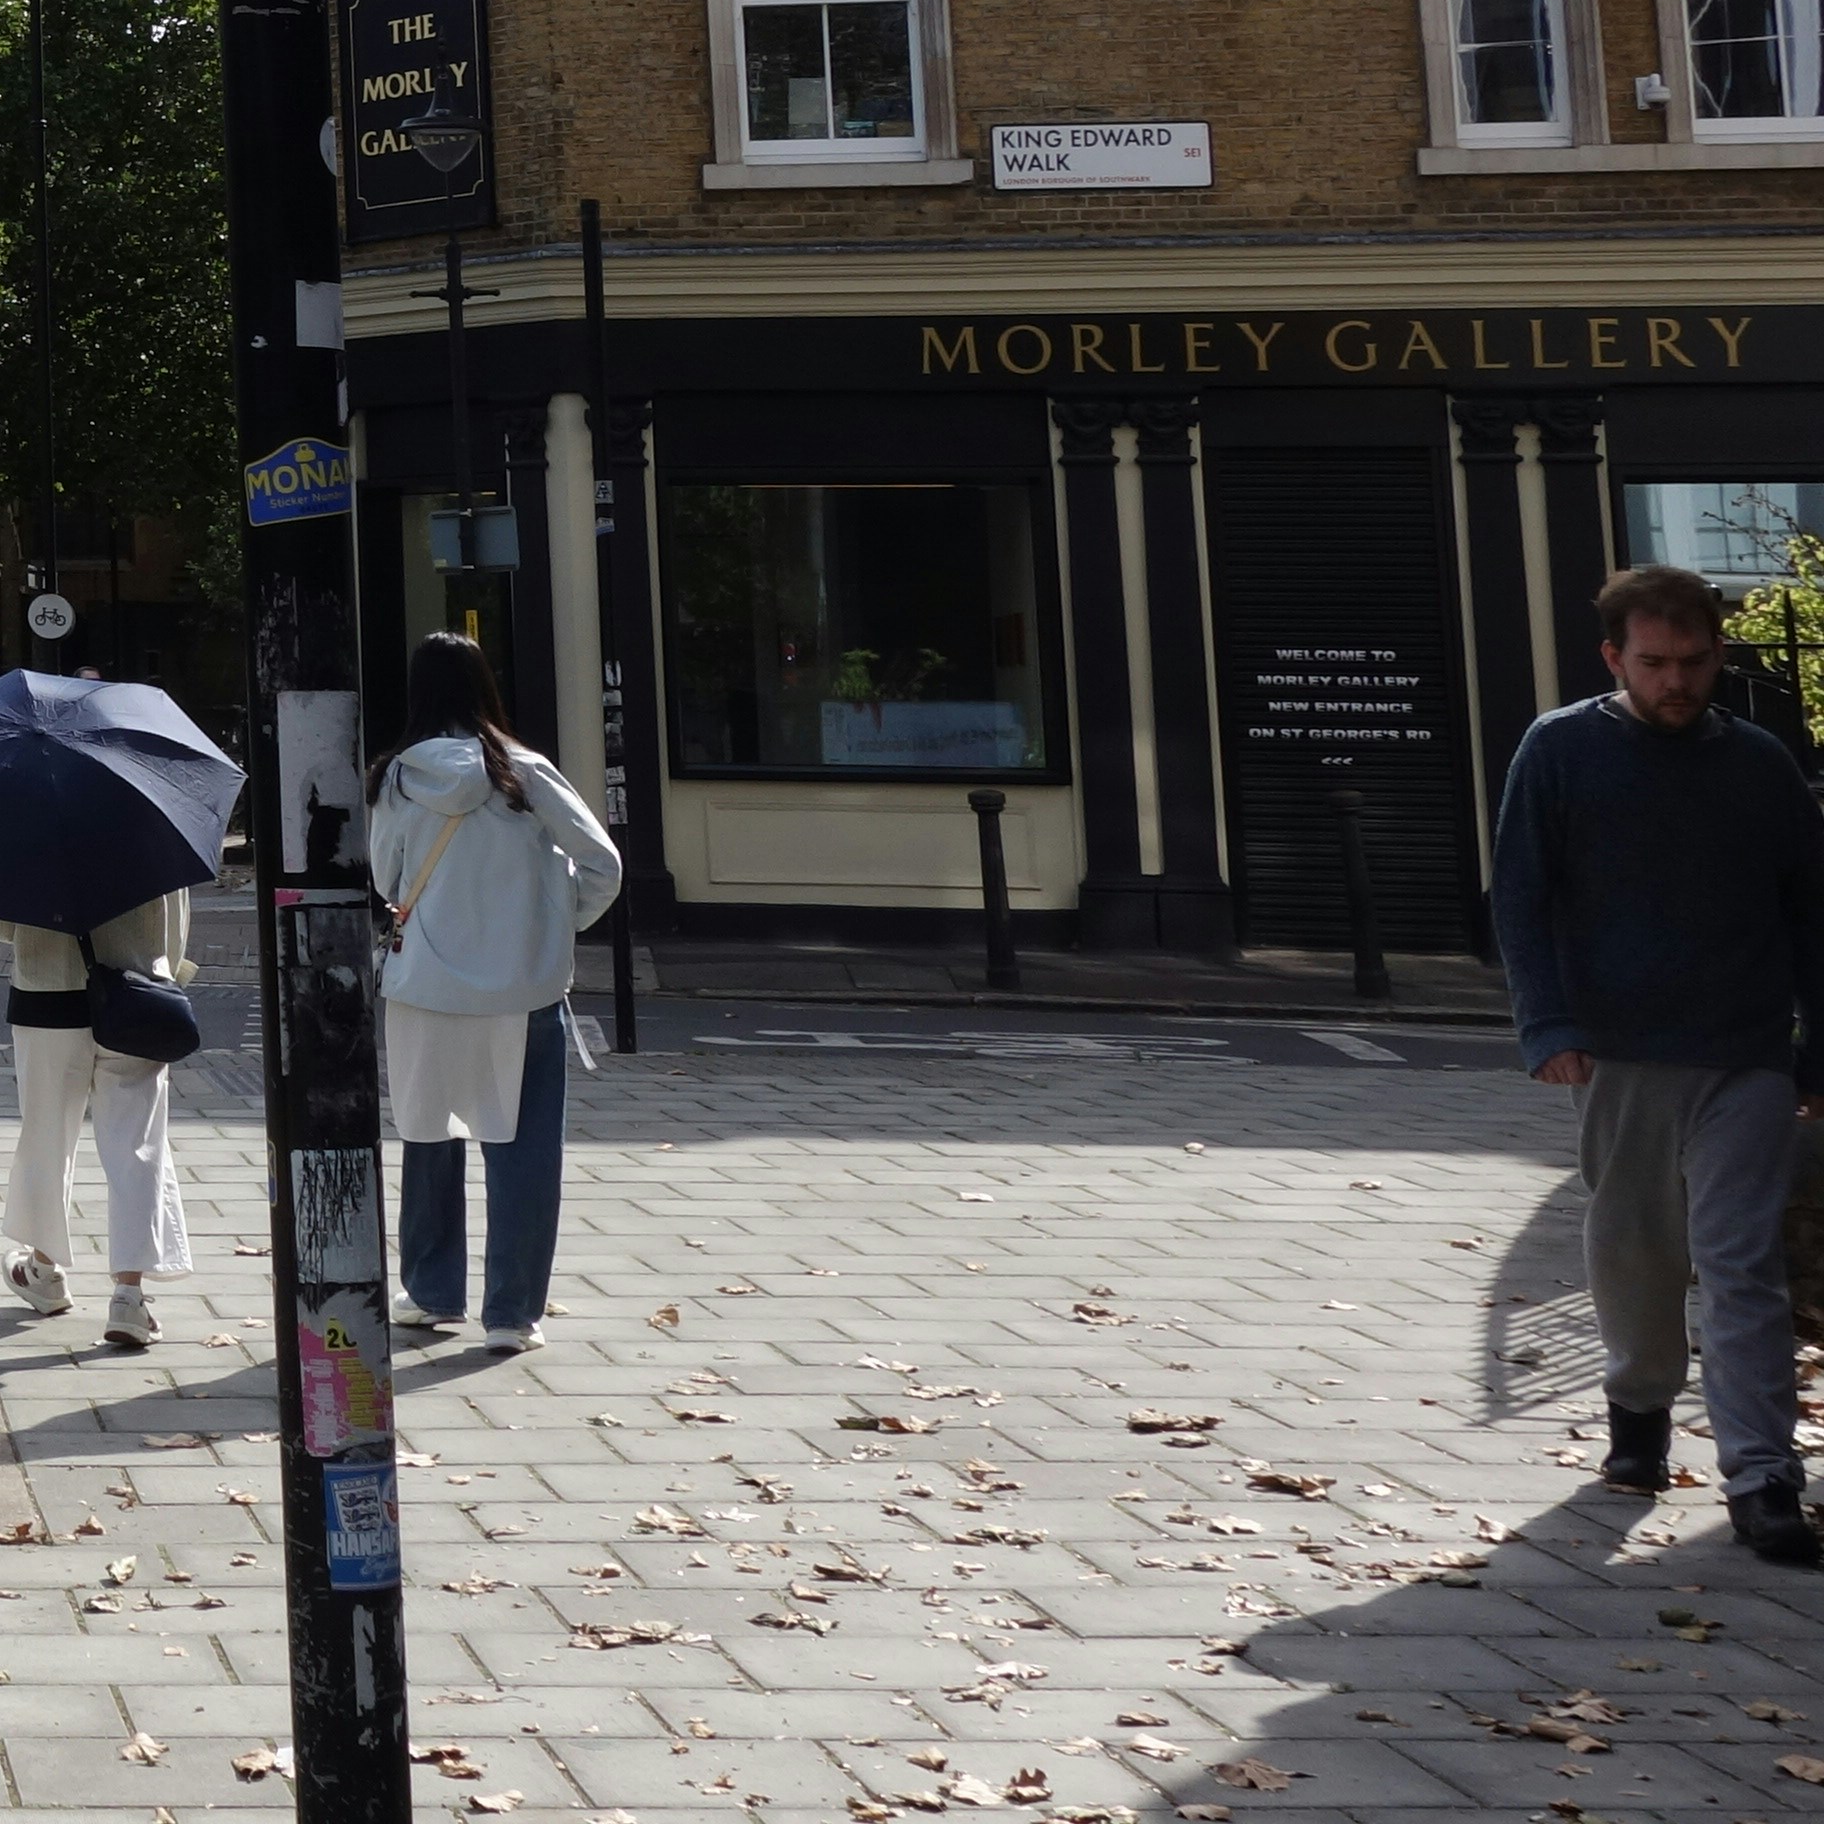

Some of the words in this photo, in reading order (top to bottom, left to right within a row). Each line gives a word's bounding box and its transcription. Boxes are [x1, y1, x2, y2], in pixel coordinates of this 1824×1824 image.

[388, 13, 436, 44] THE
[362, 61, 468, 103] MORLY
[1001, 130, 1062, 148] KING
[1071, 128, 1172, 147] EDWARD
[1183, 148, 1201, 158] SE1
[1003, 153, 1071, 172] WALK
[921, 323, 1284, 375] MORLEY
[1325, 317, 1754, 371] GALLERY
[270, 496, 308, 509] Sticker
[1276, 649, 1366, 661] WELCOME
[1371, 650, 1396, 661] TO
[1257, 675, 1332, 687] MORLEY
[1337, 676, 1420, 687] GALLERY
[1268, 701, 1309, 712] NEW
[1314, 702, 1413, 713] ENTRANCE
[1249, 728, 1275, 738] ON
[1280, 728, 1303, 738] ST
[1308, 728, 1400, 740] GEORGE'S
[1406, 729, 1432, 740] RD
